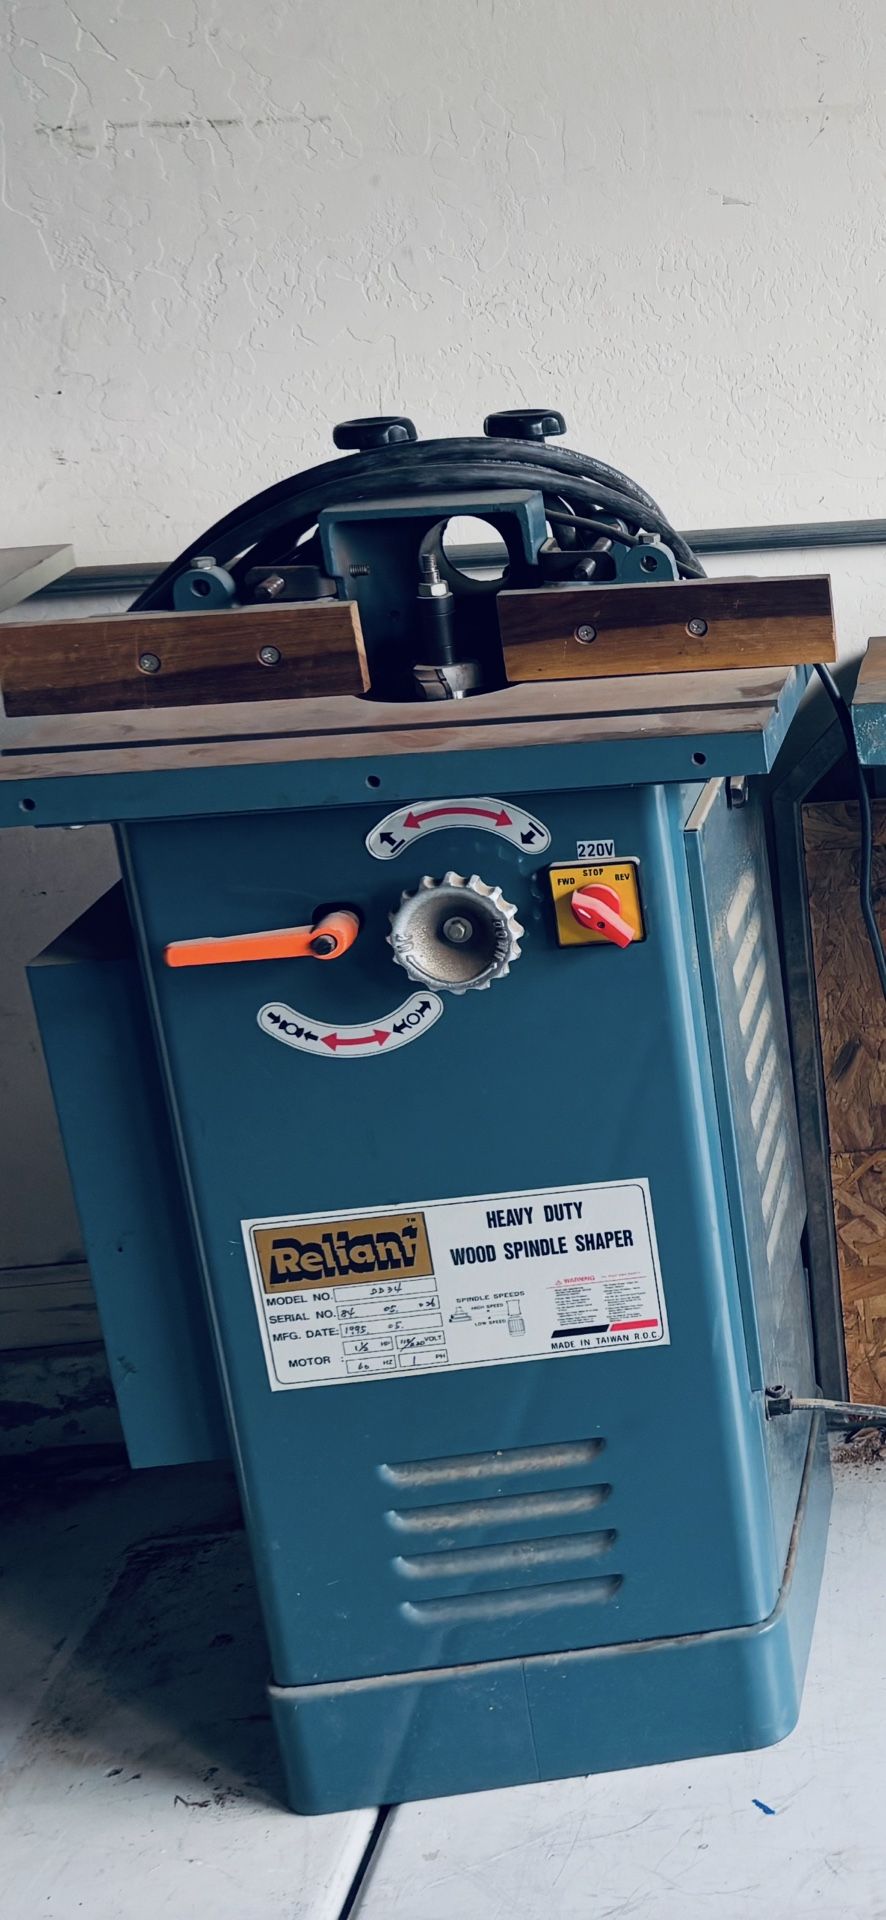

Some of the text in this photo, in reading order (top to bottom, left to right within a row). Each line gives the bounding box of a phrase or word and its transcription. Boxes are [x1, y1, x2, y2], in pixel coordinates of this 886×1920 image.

[577, 842, 614, 858] 220V
[583, 868, 604, 877] STOP
[614, 873, 630, 881] REV
[557, 877, 576, 886] FWD
[486, 1201, 583, 1229] HEAVY DUTY
[269, 1225, 418, 1285] Reliant
[450, 1229, 634, 1266] WOOD SPINDLE SHAPER
[266, 1292, 334, 1306] MODEL NO.
[456, 1290, 525, 1303] SPINDLE SPEEDS
[268, 1309, 337, 1324] SERIAL NO.
[272, 1327, 340, 1342] MFG. DATE:
[551, 1331, 660, 1351] MADE IN TAIWAN R.O.C.
[288, 1356, 331, 1368] MOTOR
